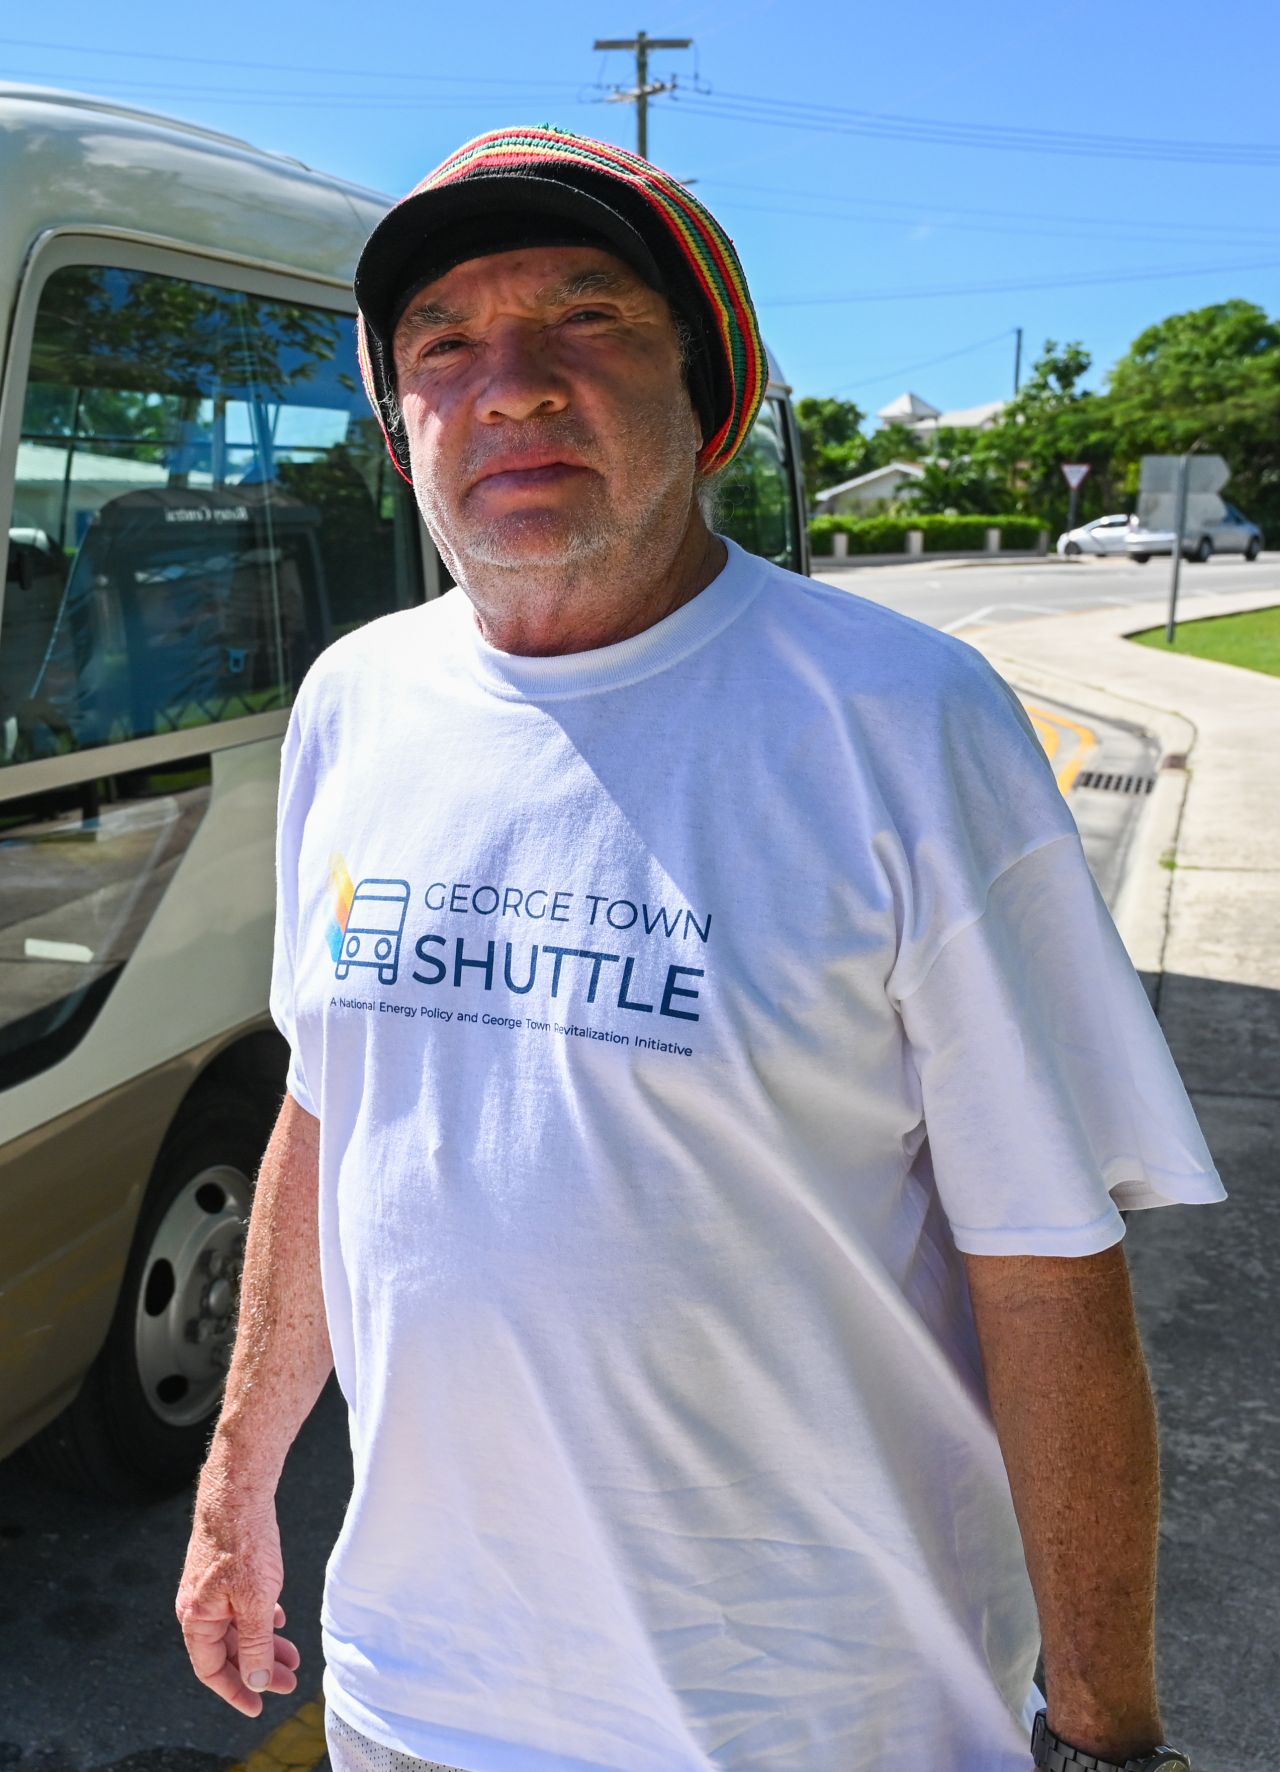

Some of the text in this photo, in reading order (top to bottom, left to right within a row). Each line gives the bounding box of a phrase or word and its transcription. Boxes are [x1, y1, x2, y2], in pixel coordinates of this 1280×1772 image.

[424, 882, 713, 944] GEORGE TOWN
[412, 934, 706, 1022] SHUTTLE
[330, 997, 693, 1057] A National Energy Policy and George Town Revitalization Initiative
